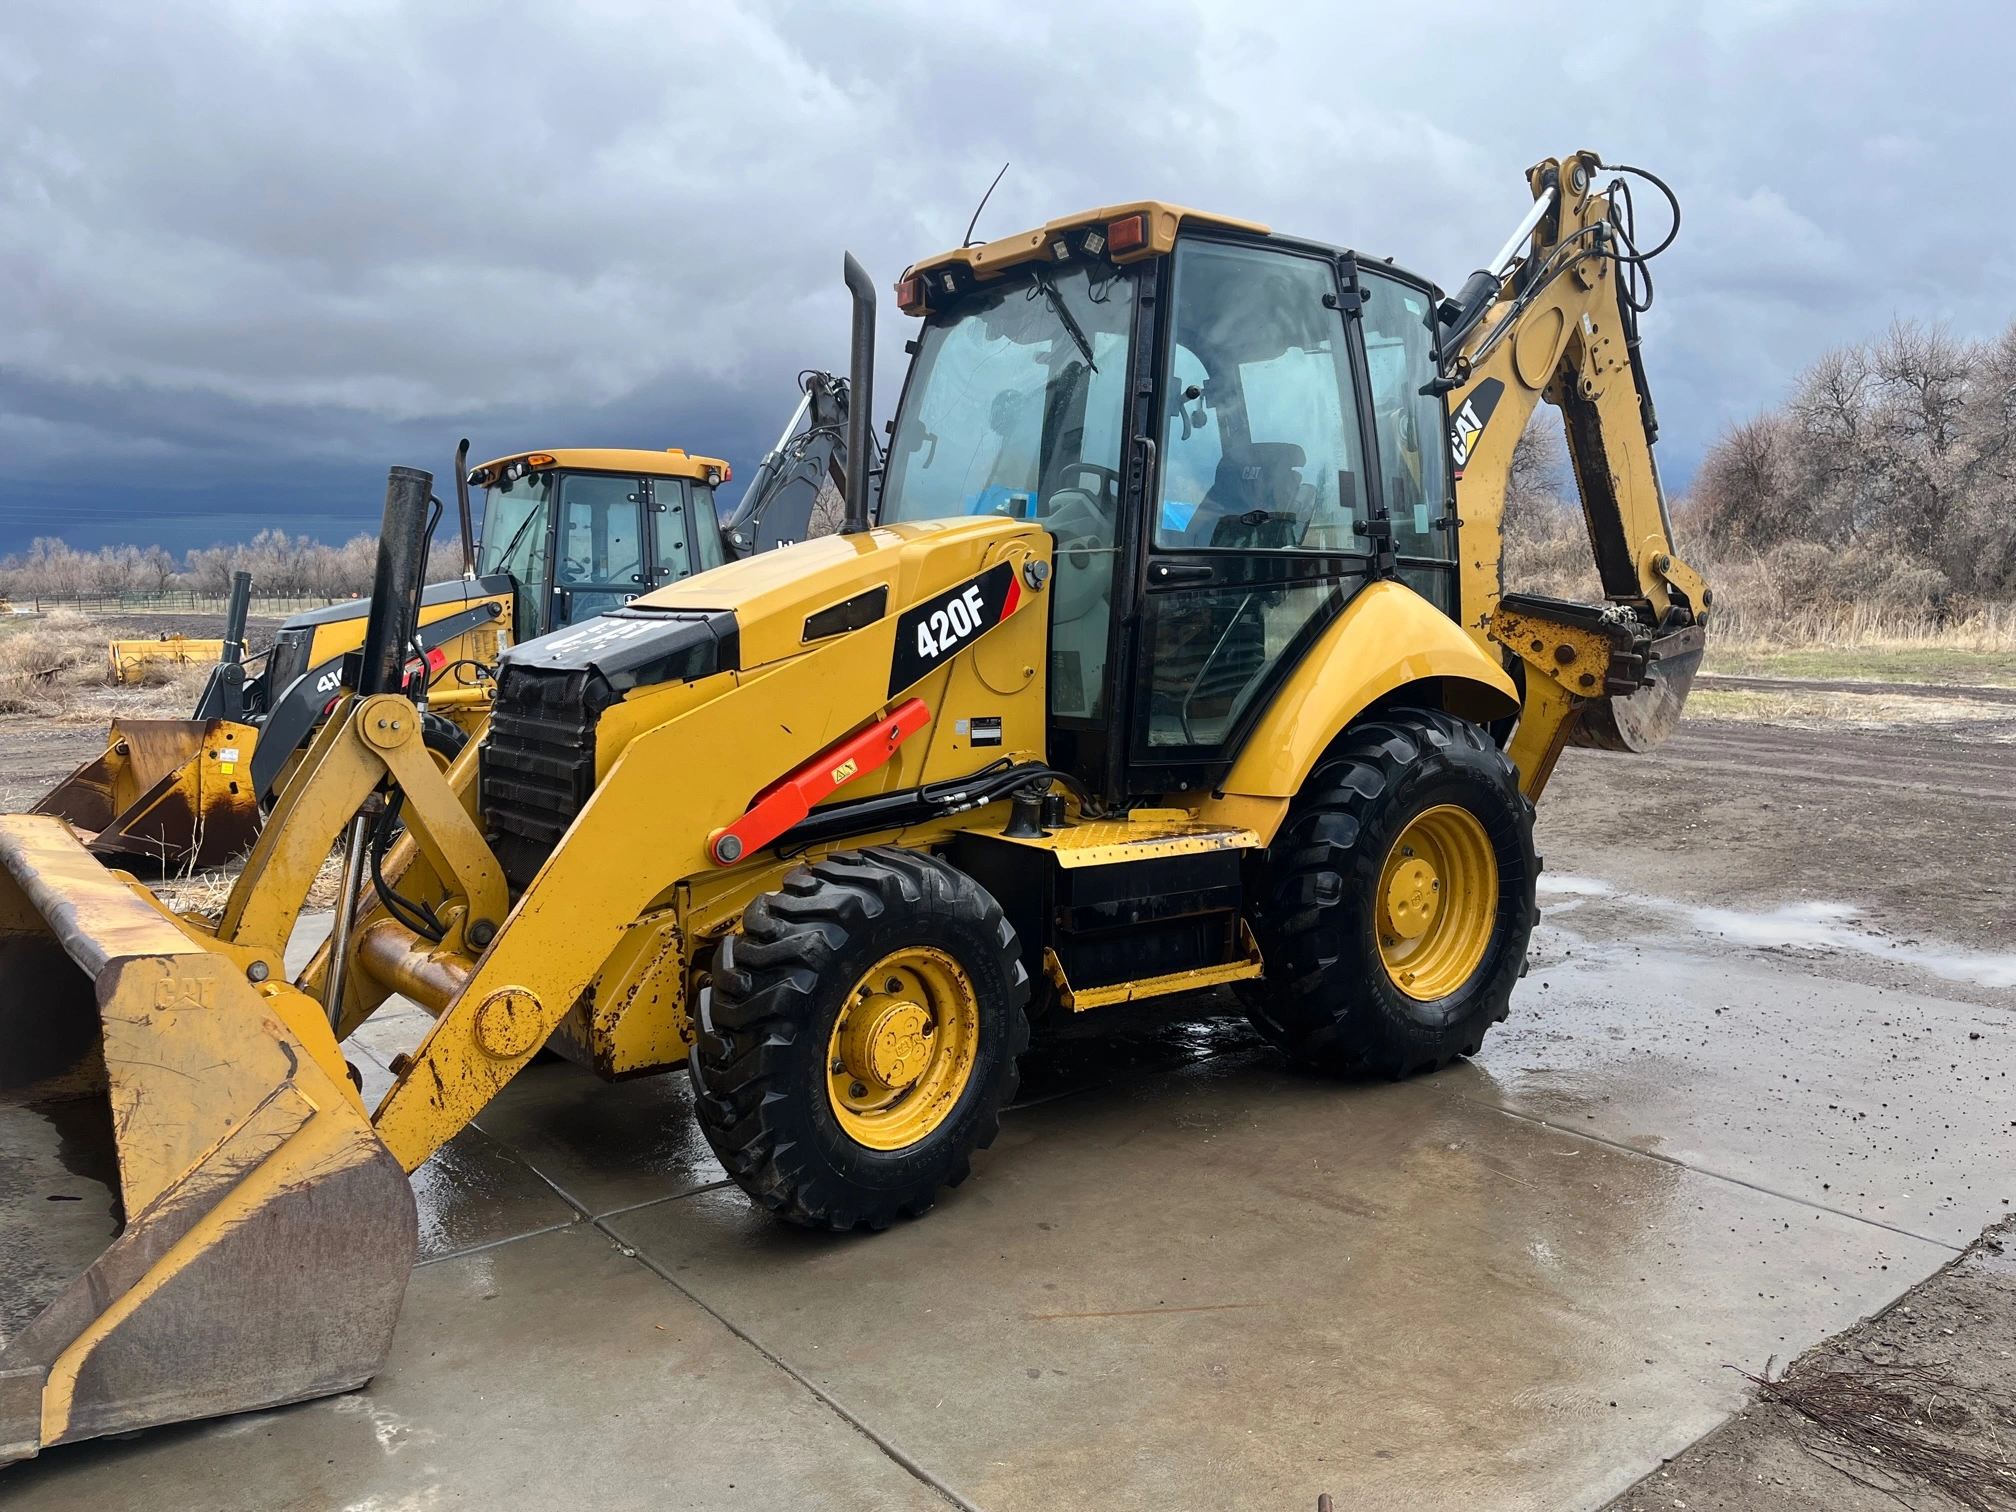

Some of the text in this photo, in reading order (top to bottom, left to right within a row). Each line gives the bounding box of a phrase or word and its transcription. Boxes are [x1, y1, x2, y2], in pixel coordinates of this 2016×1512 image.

[1452, 399, 1483, 465] CAT
[1242, 467, 1261, 479] CAT
[917, 585, 984, 658] 420F
[154, 977, 216, 1011] CAT
